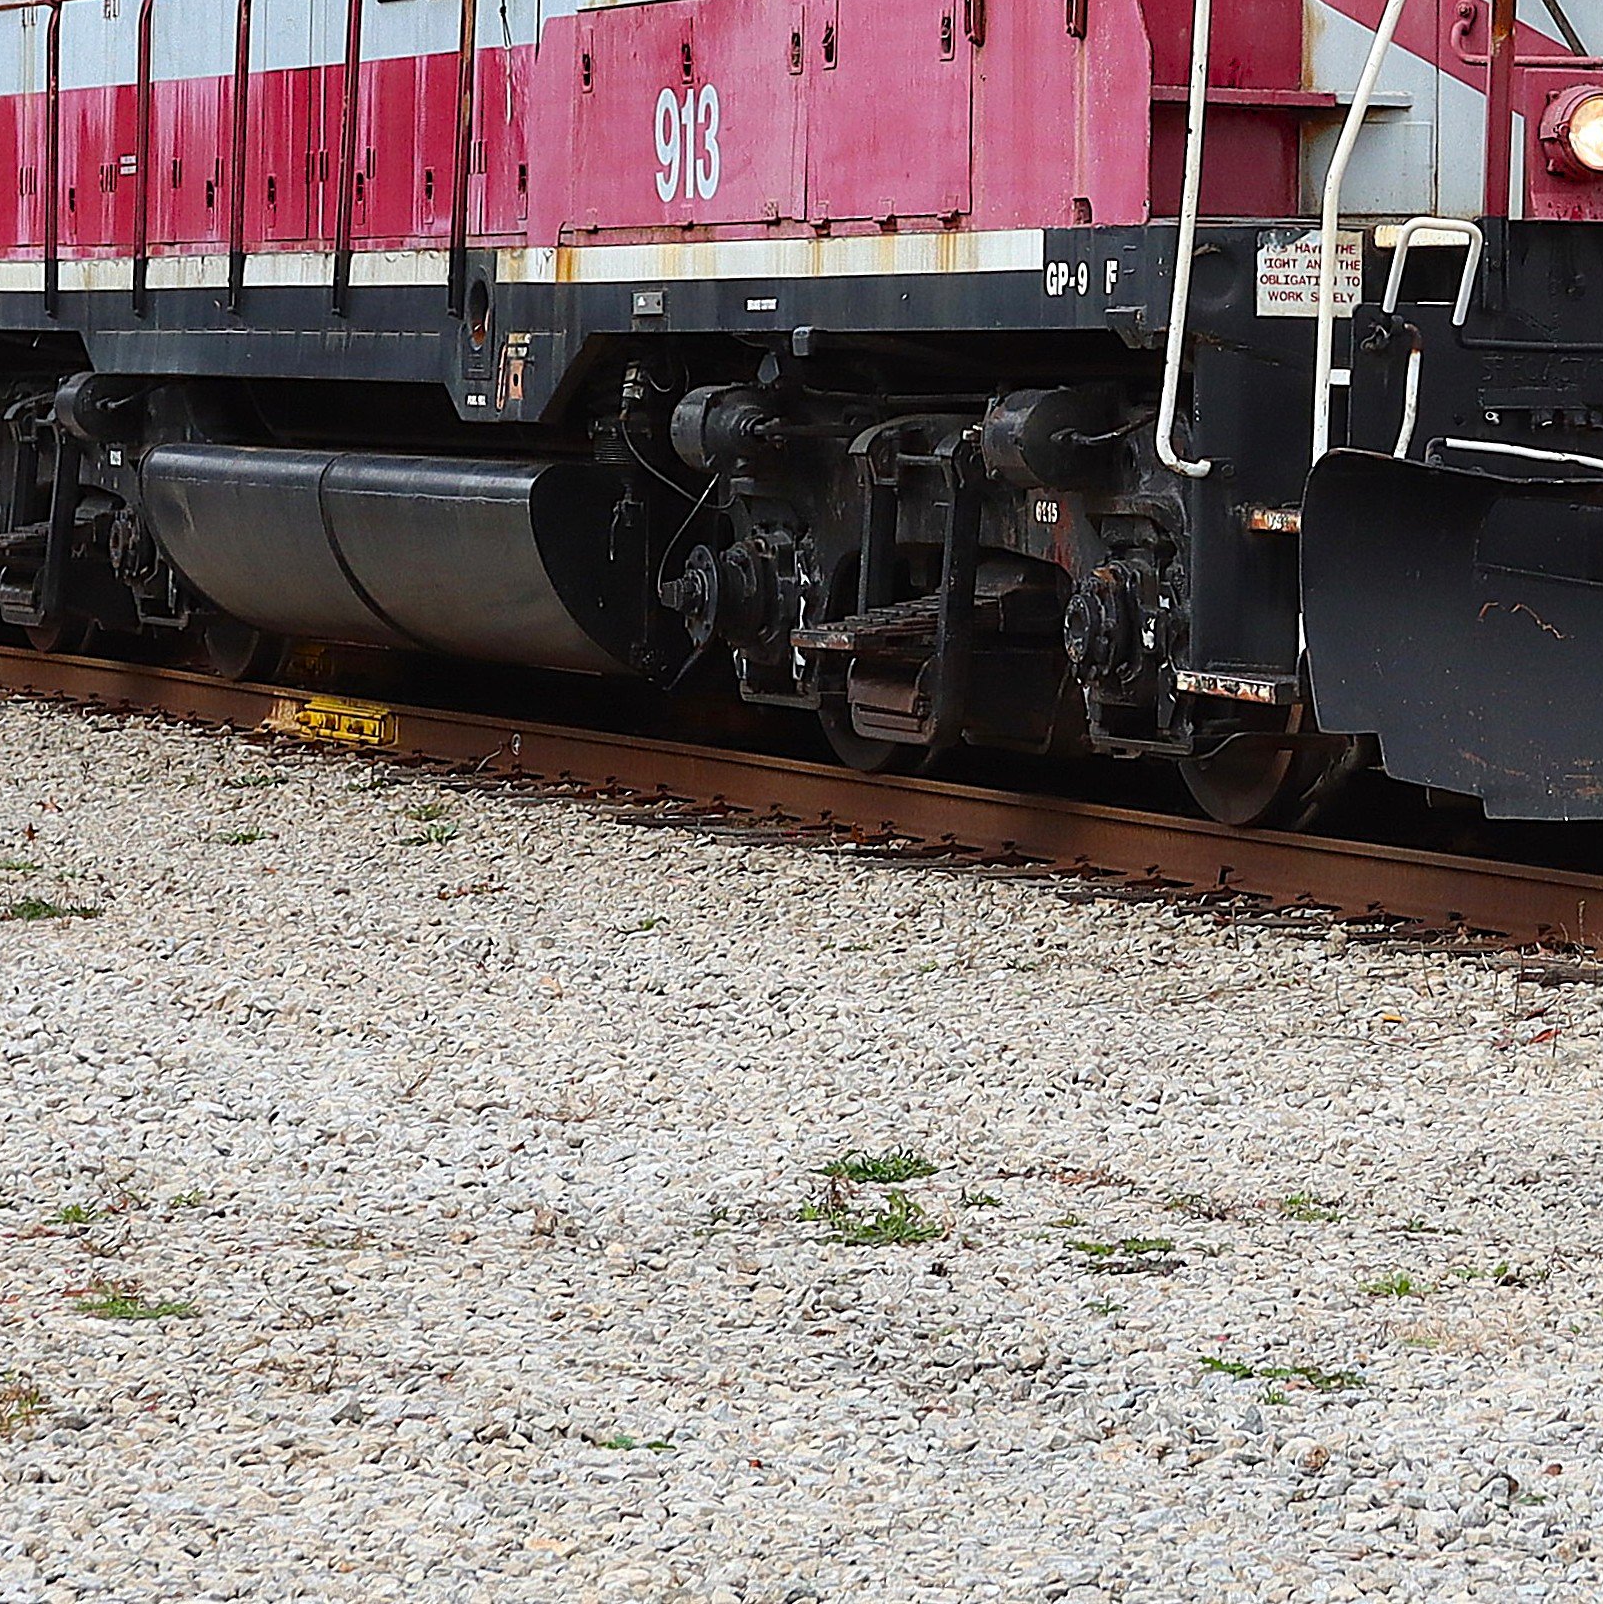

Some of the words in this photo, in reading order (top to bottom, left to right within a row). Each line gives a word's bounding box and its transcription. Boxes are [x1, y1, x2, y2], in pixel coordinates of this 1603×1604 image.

[654, 83, 721, 203] 913
[1264, 258, 1299, 269] IGHT
[1306, 259, 1322, 270] AN
[1338, 260, 1362, 271] THE
[1046, 262, 1088, 296] GP-9
[1259, 274, 1337, 286] OBLIGATI
[1345, 276, 1361, 287] TO
[1268, 291, 1304, 302] WORK
[1310, 292, 1355, 303] SELY
